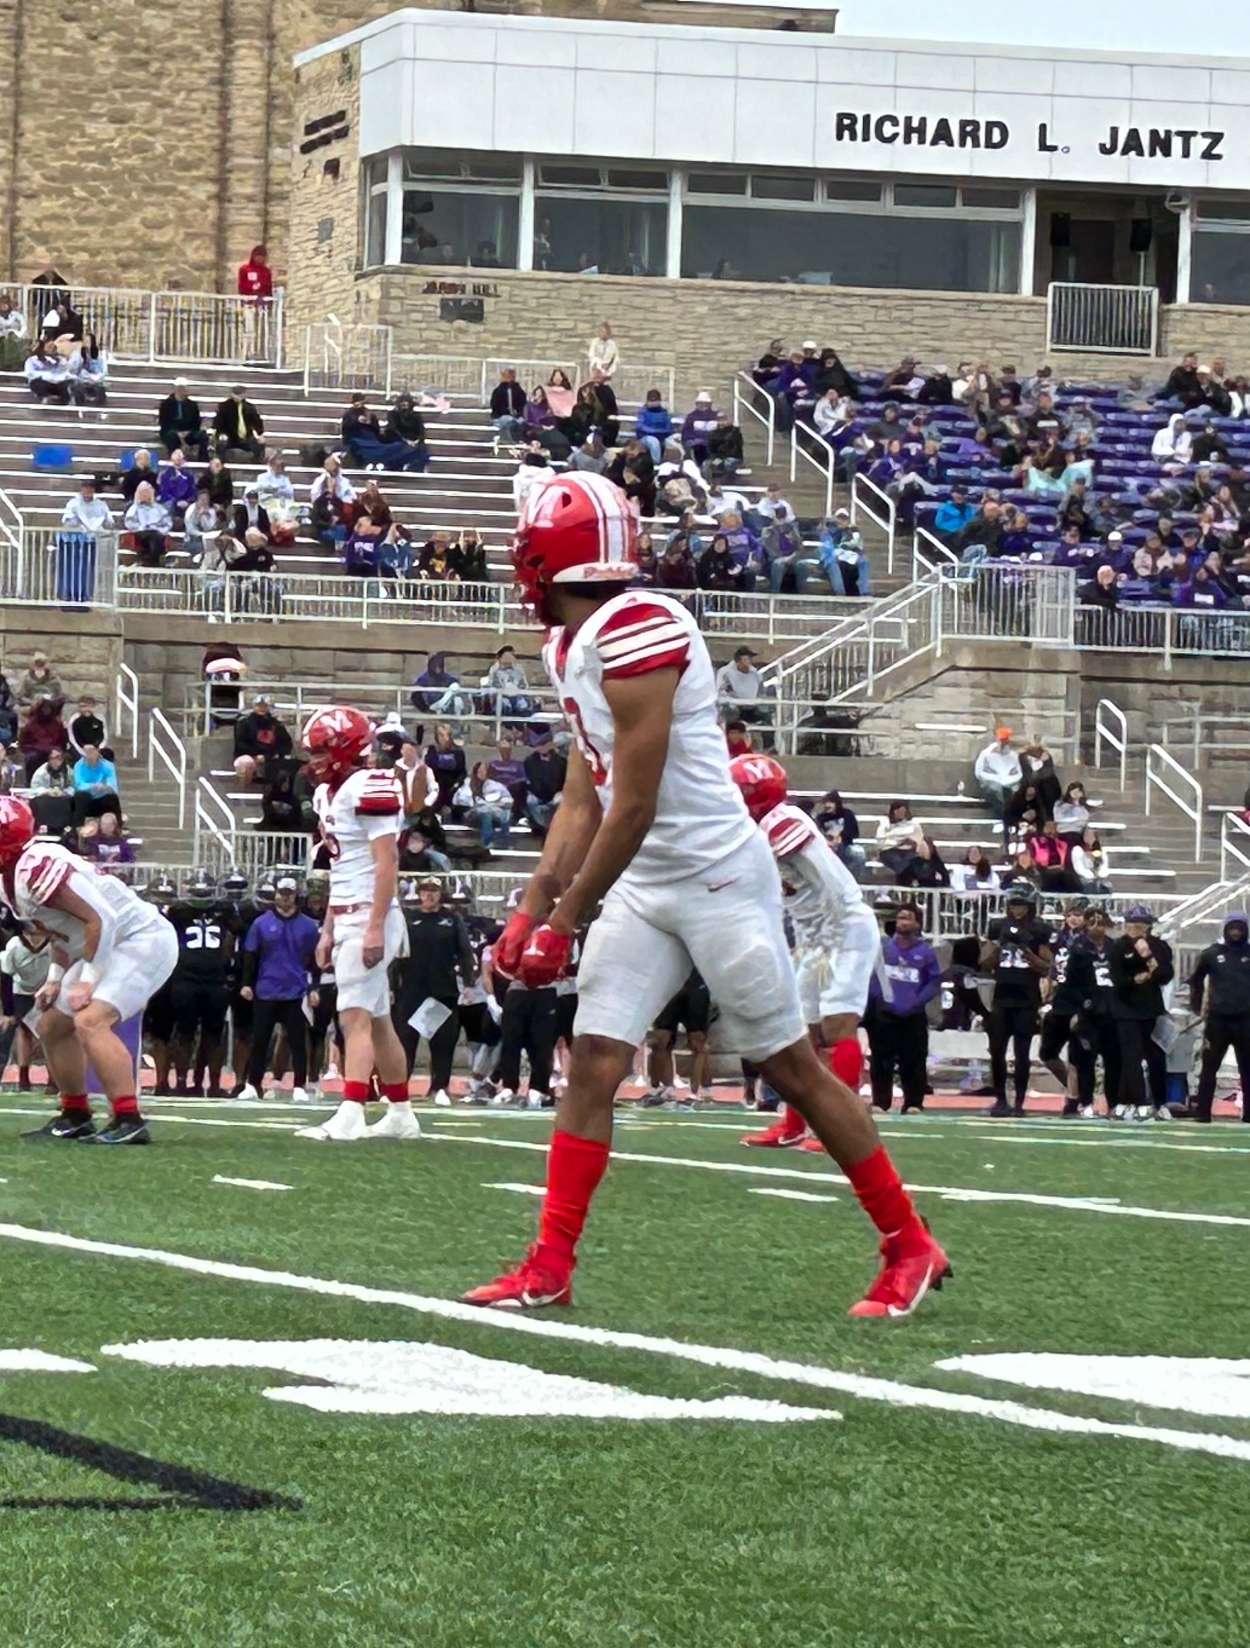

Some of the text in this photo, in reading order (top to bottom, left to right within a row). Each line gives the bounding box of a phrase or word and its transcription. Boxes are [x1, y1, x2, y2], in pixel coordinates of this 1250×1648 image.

[835, 111, 1225, 160] RICHARD L. JANTZ
[319, 710, 353, 737] M
